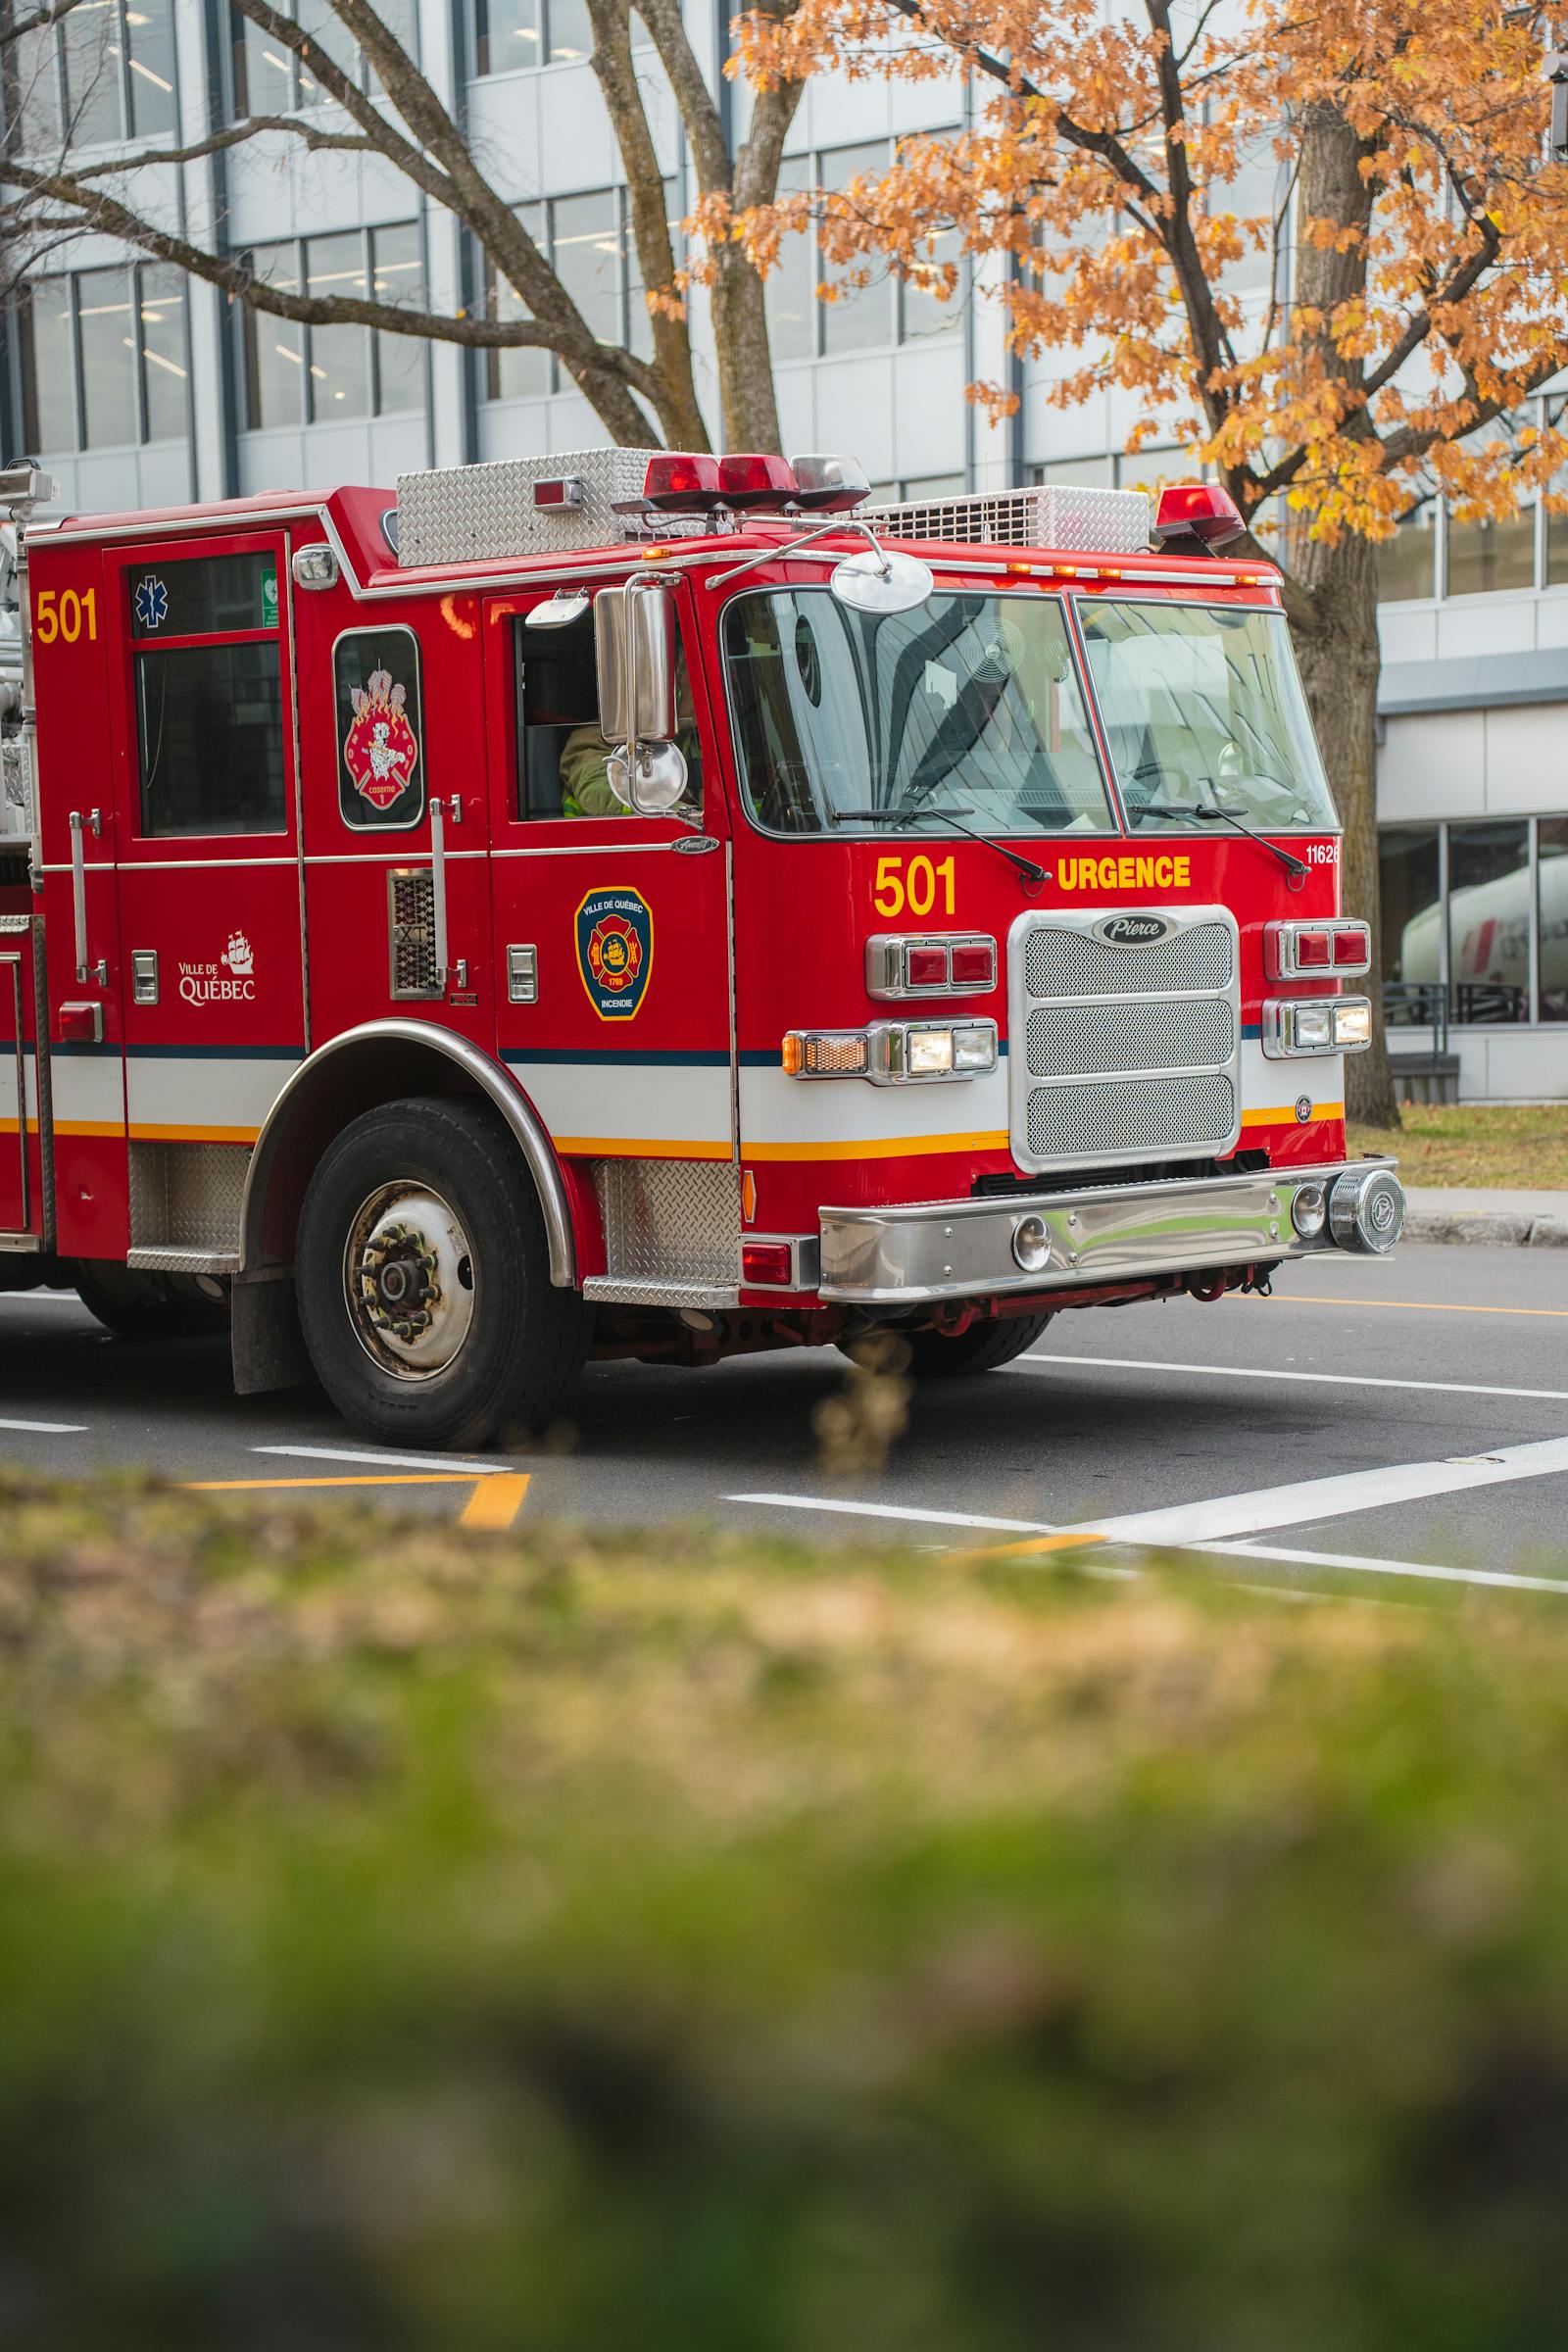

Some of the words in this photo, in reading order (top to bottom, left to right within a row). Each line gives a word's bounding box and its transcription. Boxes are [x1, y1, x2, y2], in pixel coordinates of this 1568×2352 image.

[37, 587, 97, 644] 501
[874, 855, 956, 917] 501
[1057, 856, 1191, 890] URGENCE
[582, 902, 604, 916] VILLE
[603, 901, 614, 909] DE
[613, 899, 644, 913] QUÉBEC
[1109, 918, 1160, 940] Pierce
[178, 962, 205, 975] VILLE
[206, 963, 219, 975] DE
[178, 975, 256, 1007] QUÉBEC
[601, 999, 633, 1008] INCENDIE
